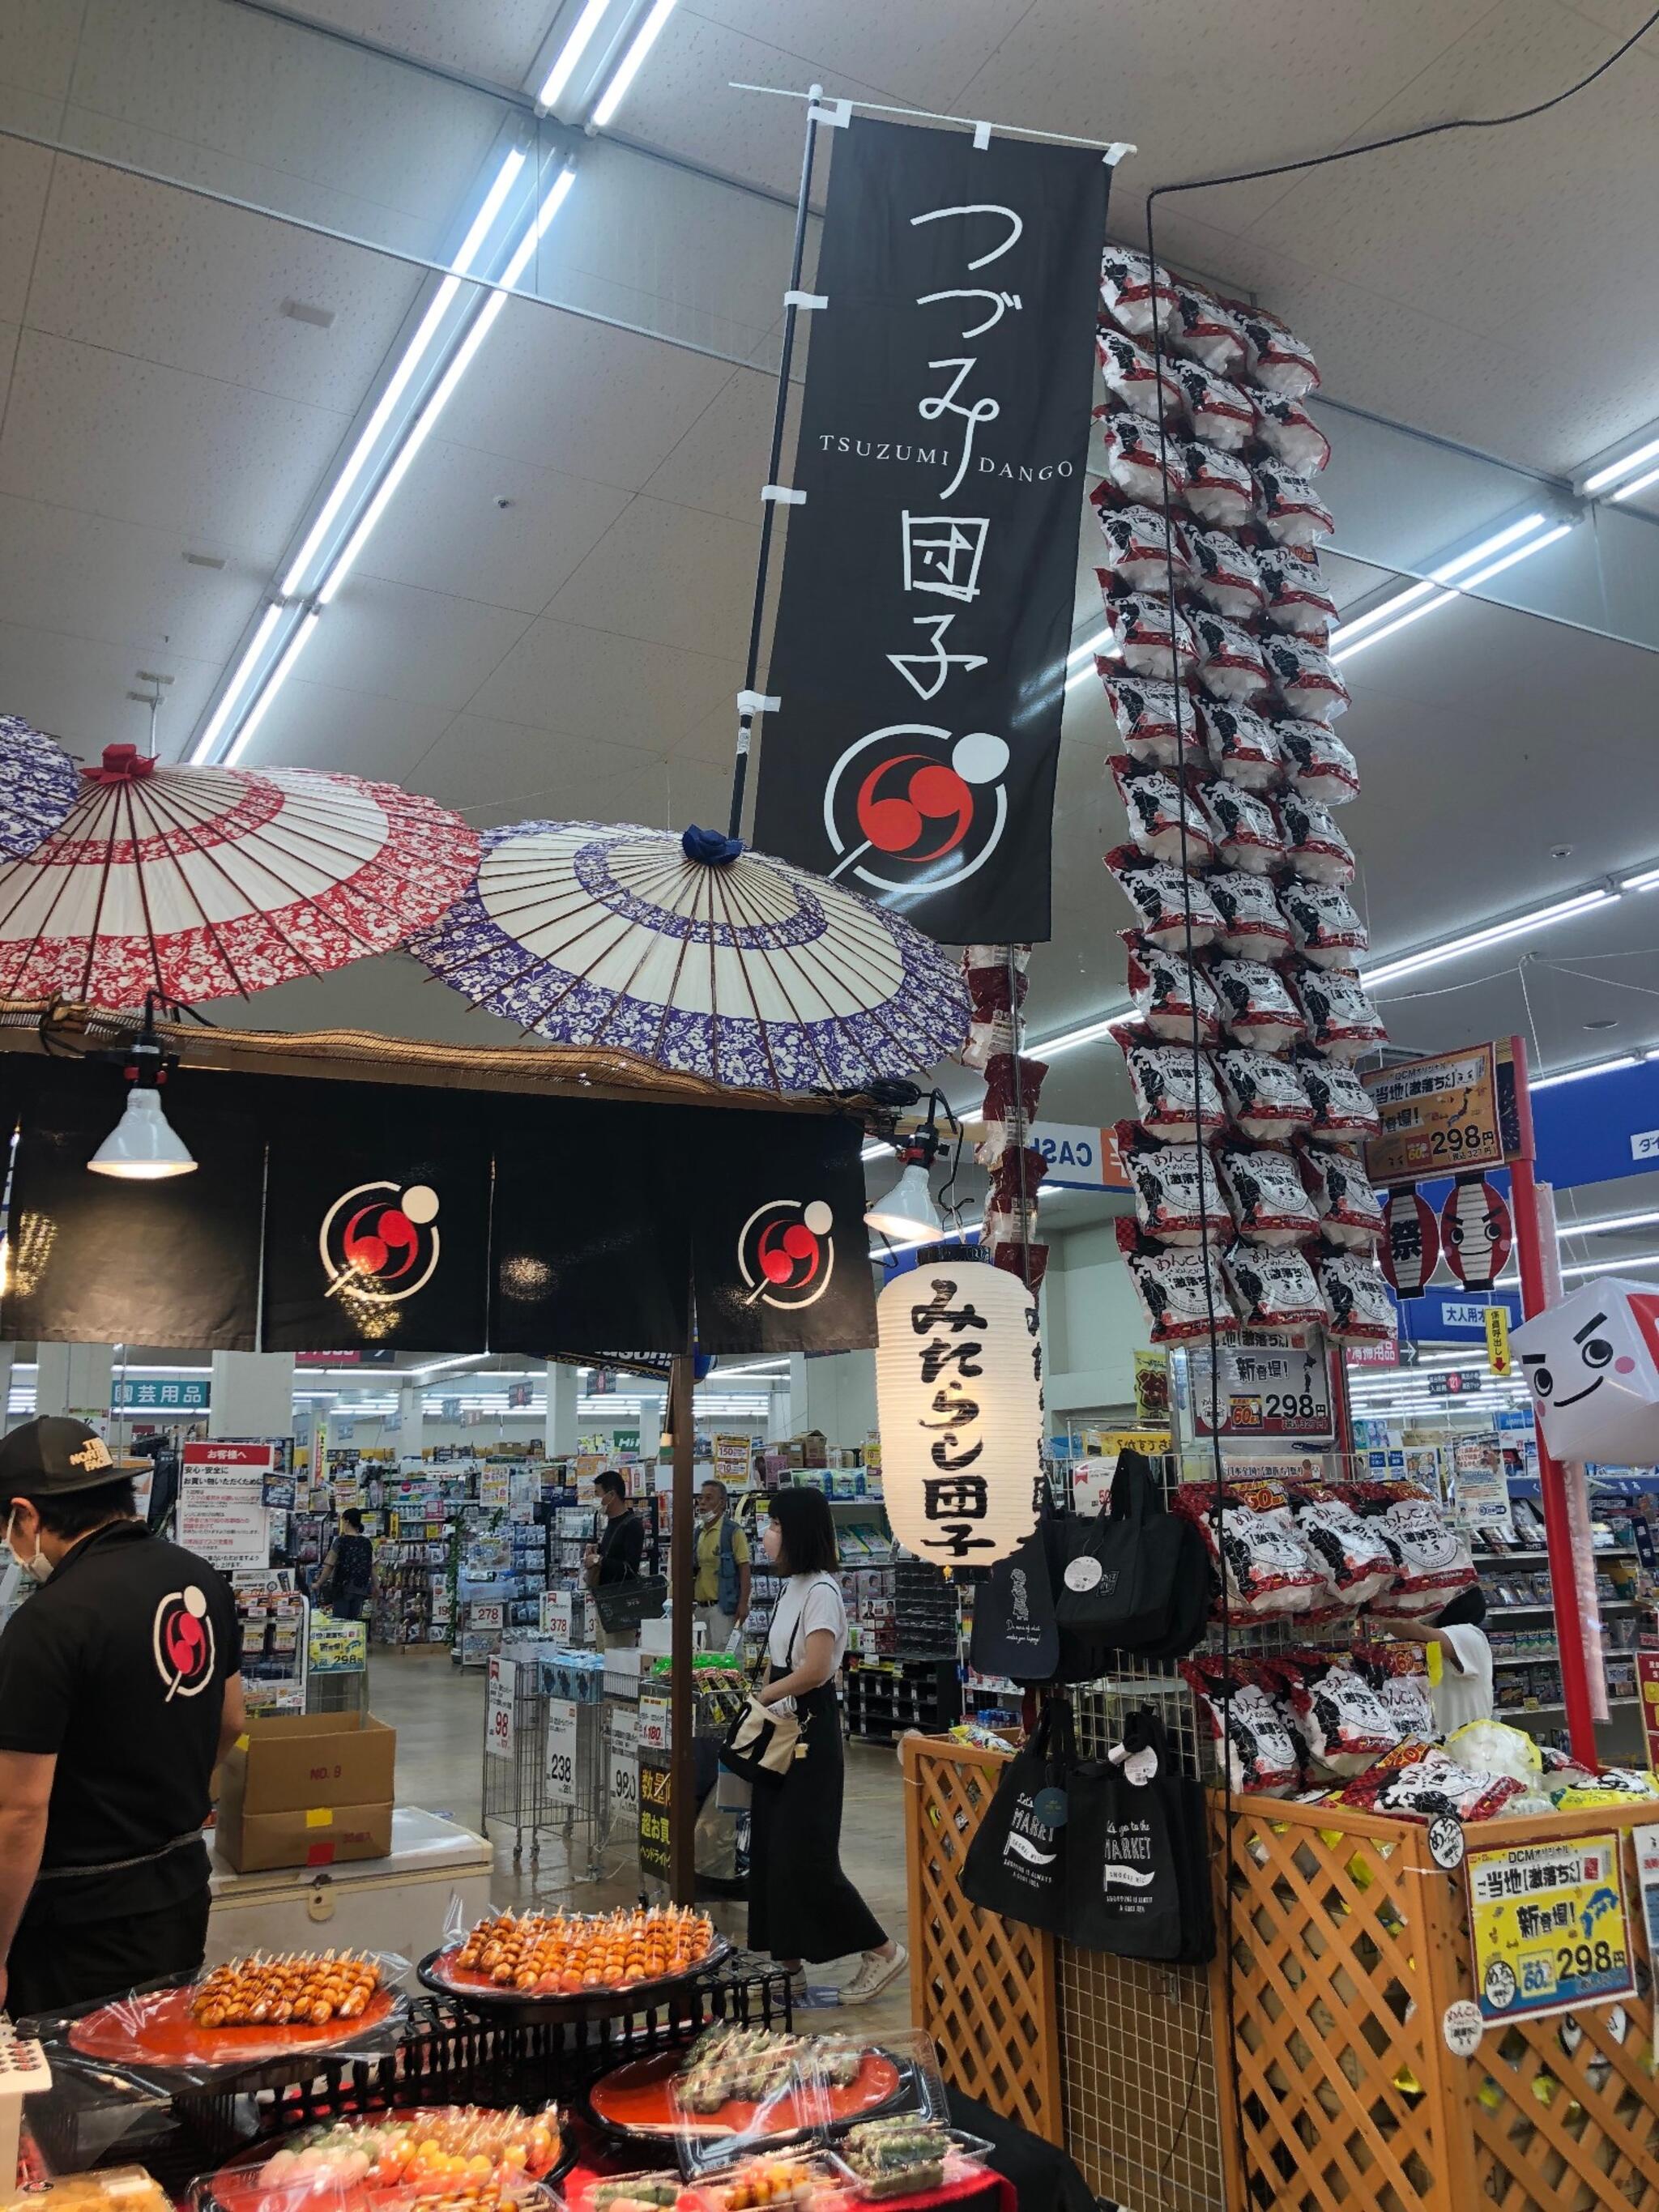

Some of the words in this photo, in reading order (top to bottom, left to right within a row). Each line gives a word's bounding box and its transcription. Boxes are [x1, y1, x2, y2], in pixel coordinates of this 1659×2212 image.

[819, 435, 949, 467] TSUZUMI
[979, 456, 1073, 483] DANGO
[886, 203, 1023, 701] つづみ団子
[1430, 1124, 1495, 1155] 298円
[1389, 1219, 1422, 1260] 祭
[114, 1385, 202, 1404] 園芸用品
[1265, 1394, 1326, 1418] 298円
[911, 1278, 997, 1558] みたらし団子
[207, 1449, 248, 1460] お客様へ
[477, 1608, 499, 1621] 278
[550, 1618, 567, 1632] 378
[495, 1711, 509, 1737] 98
[551, 1753, 572, 1784] 238
[1557, 1940, 1627, 1981] 298円
